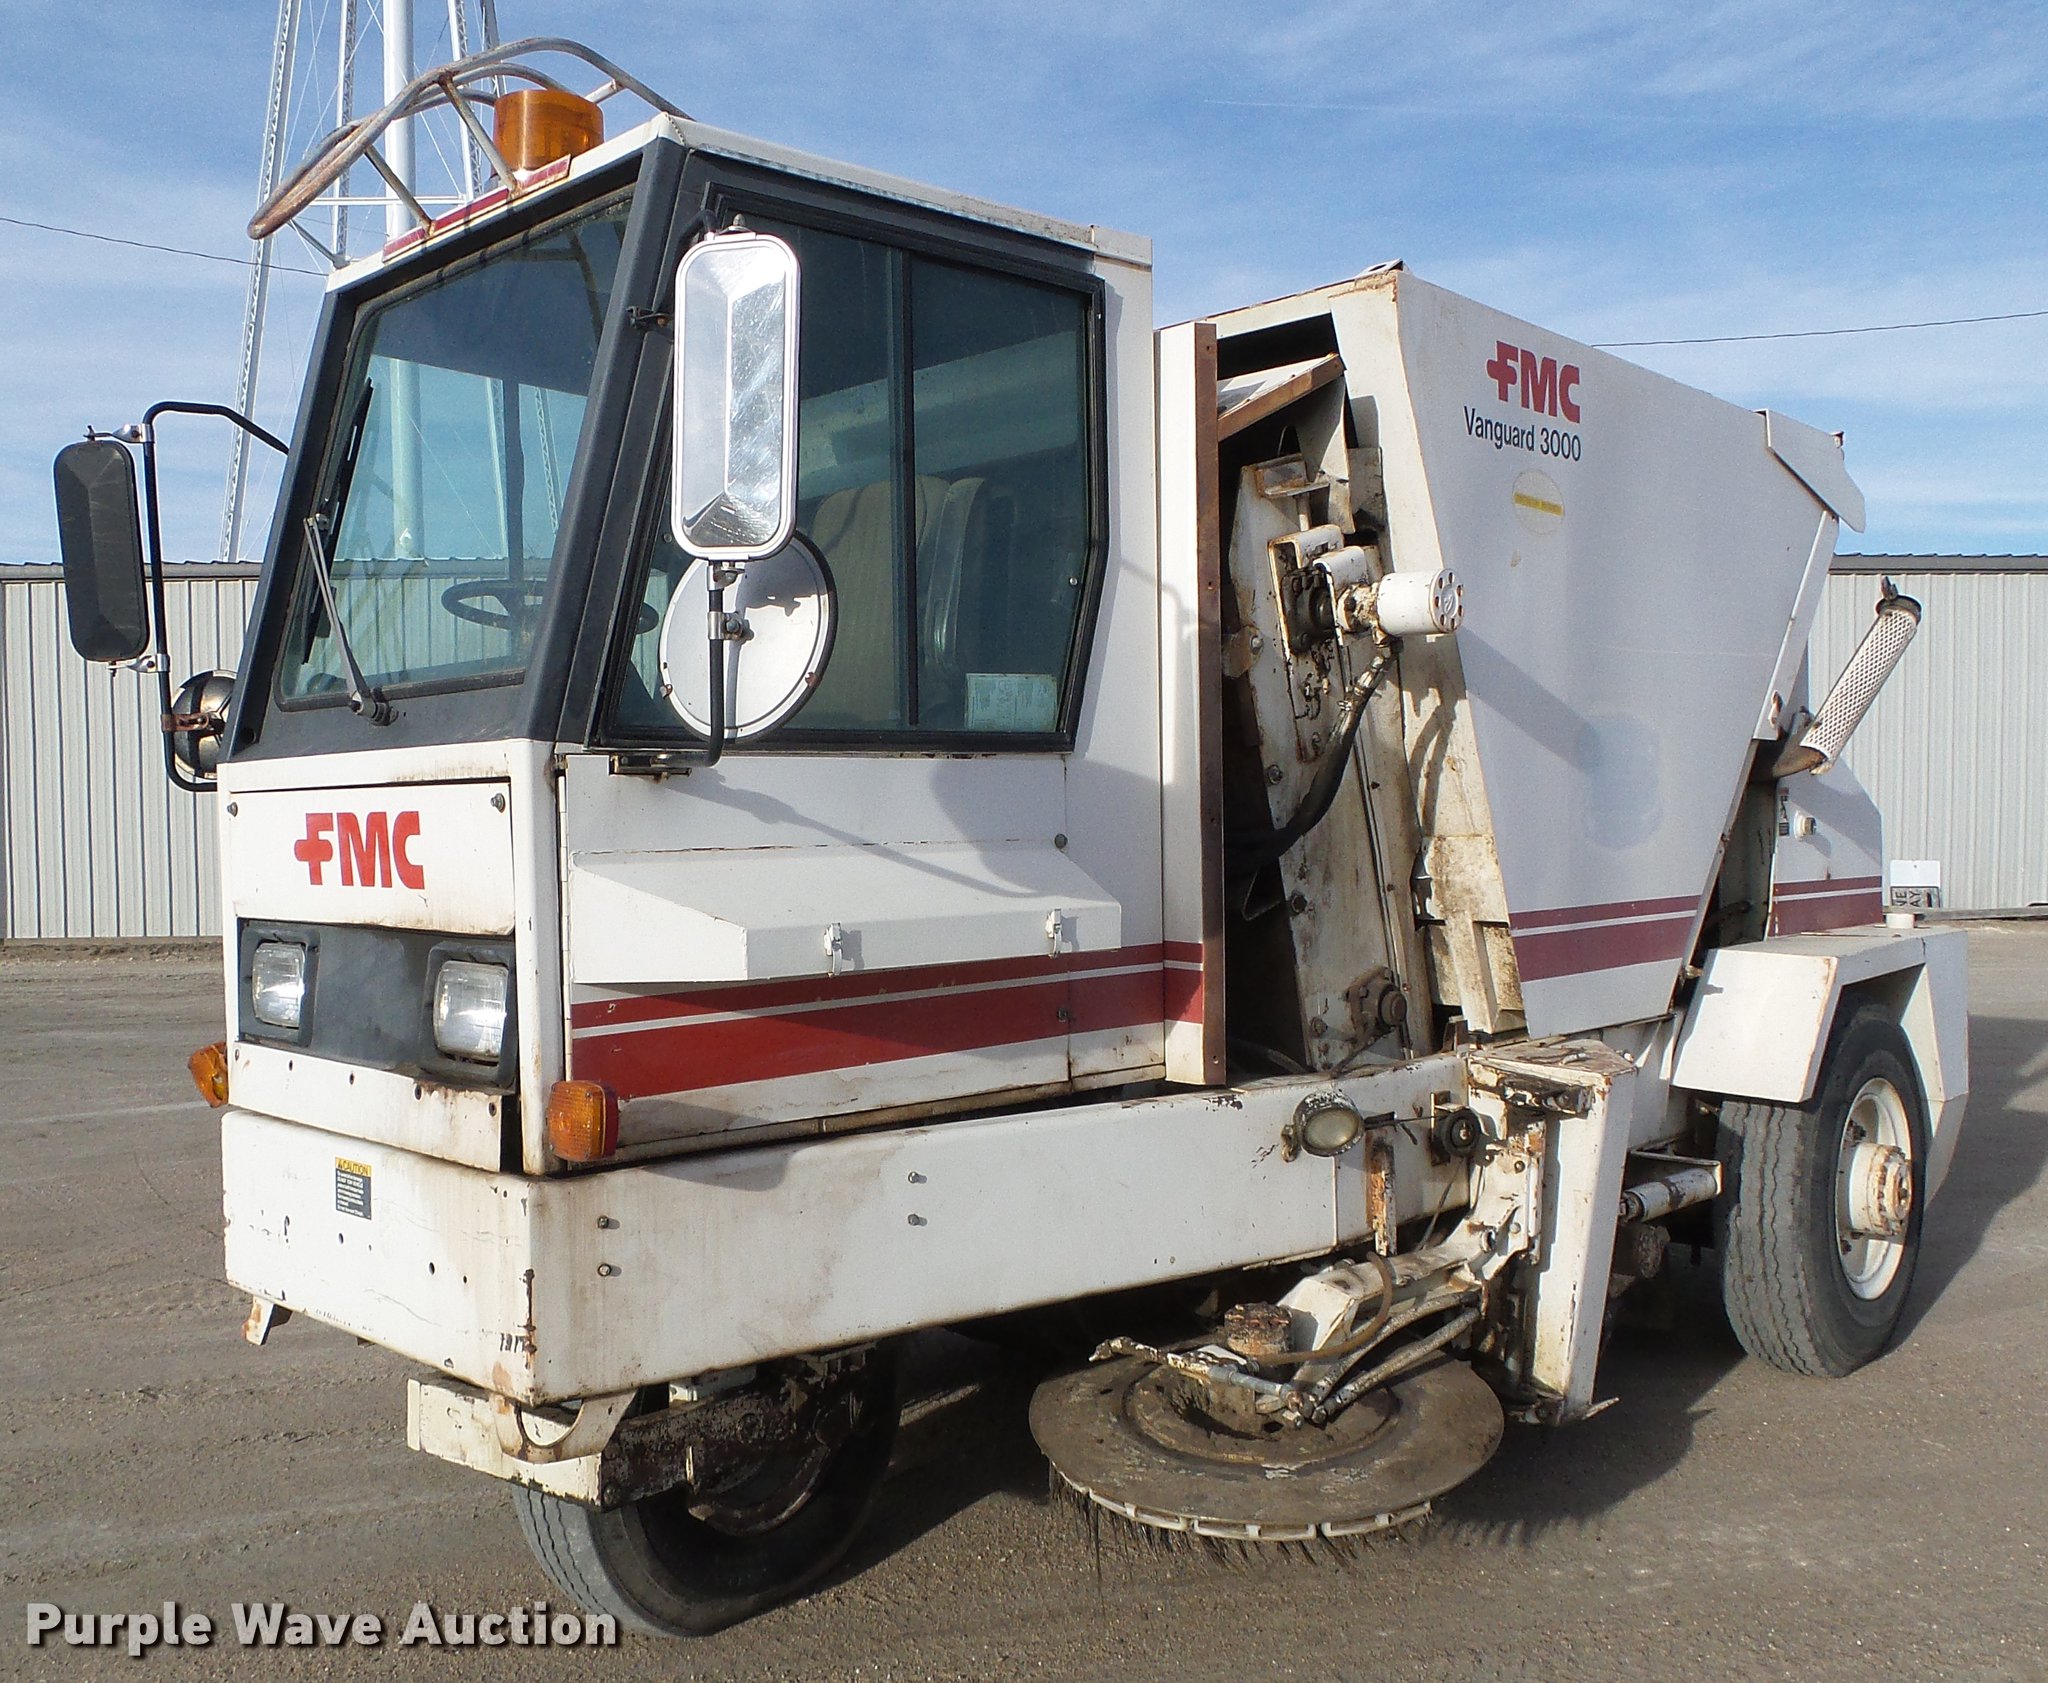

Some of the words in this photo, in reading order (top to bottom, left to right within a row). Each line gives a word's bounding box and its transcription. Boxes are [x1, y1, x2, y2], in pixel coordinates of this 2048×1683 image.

[1486, 340, 1580, 424] FMC
[1464, 405, 1535, 450] Vanguard
[1540, 427, 1582, 462] 3000
[294, 811, 425, 890] FMC
